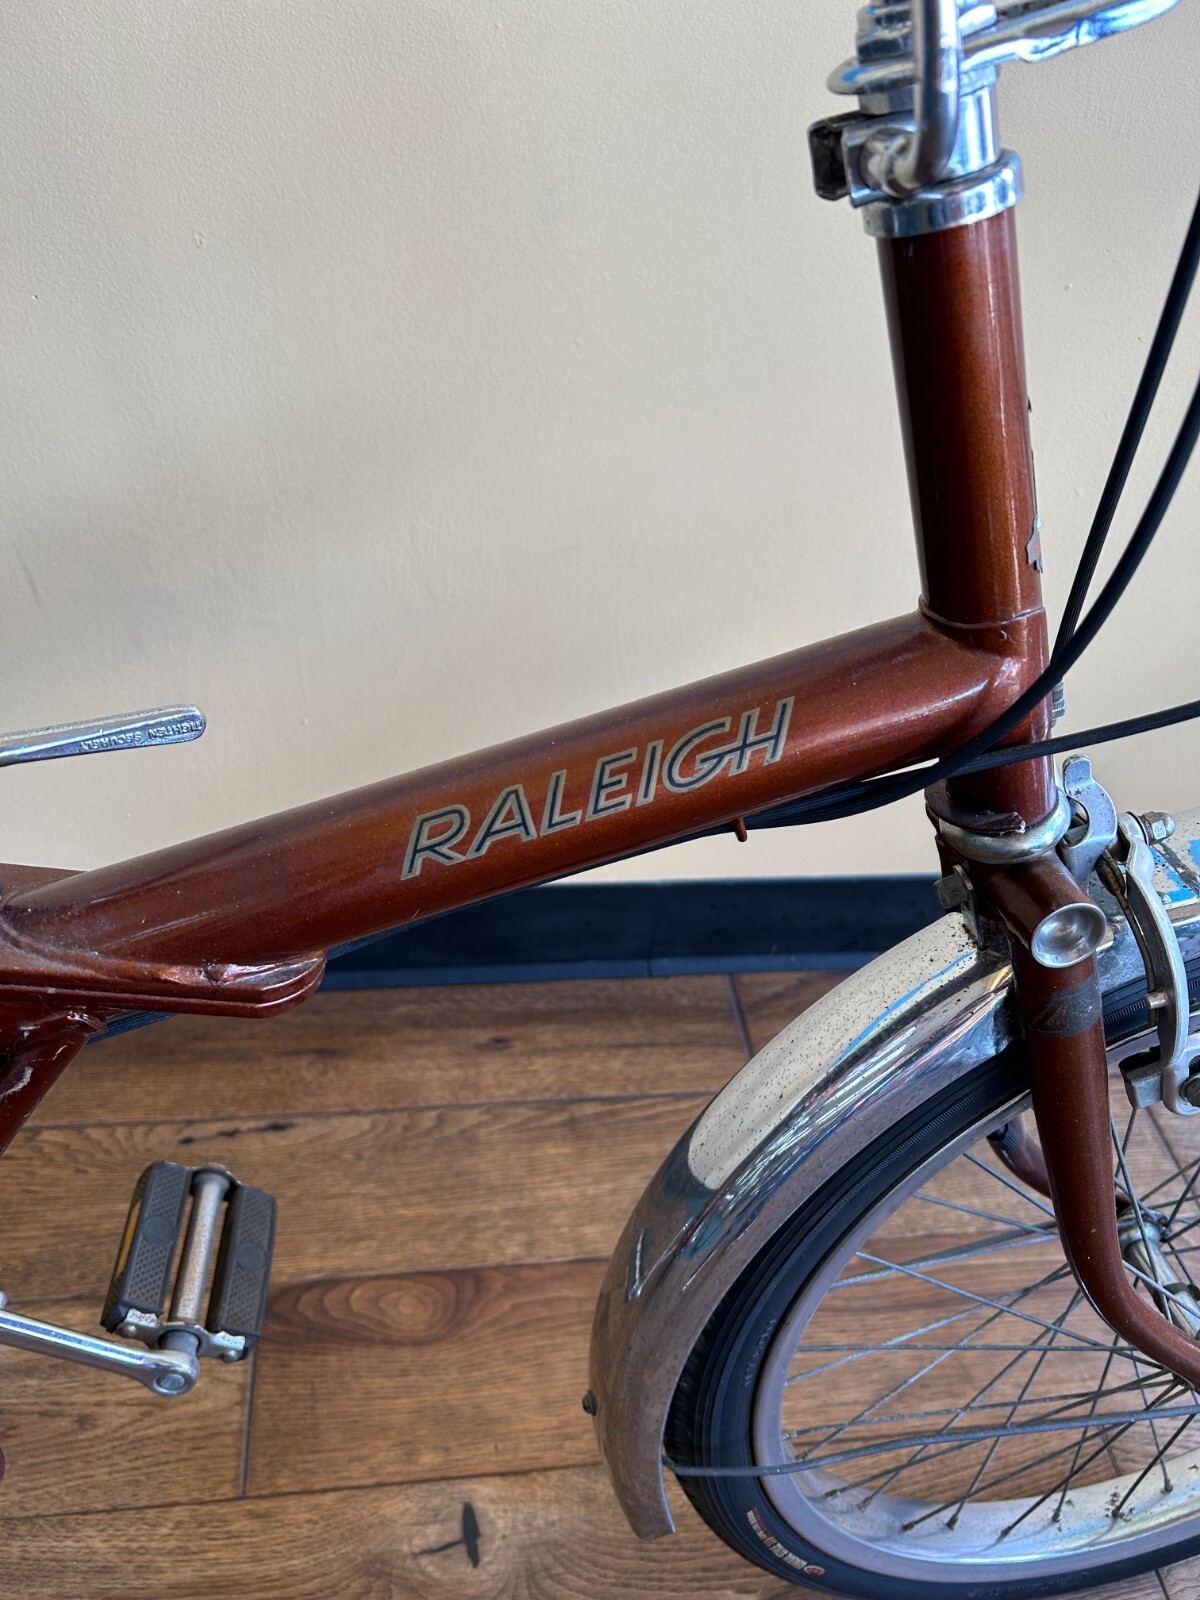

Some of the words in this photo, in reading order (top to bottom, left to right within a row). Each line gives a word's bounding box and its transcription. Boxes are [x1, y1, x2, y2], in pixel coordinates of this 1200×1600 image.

[147, 720, 203, 740] TIGHTEN
[79, 731, 142, 751] SECURELY
[400, 696, 795, 880] RALEIGH
